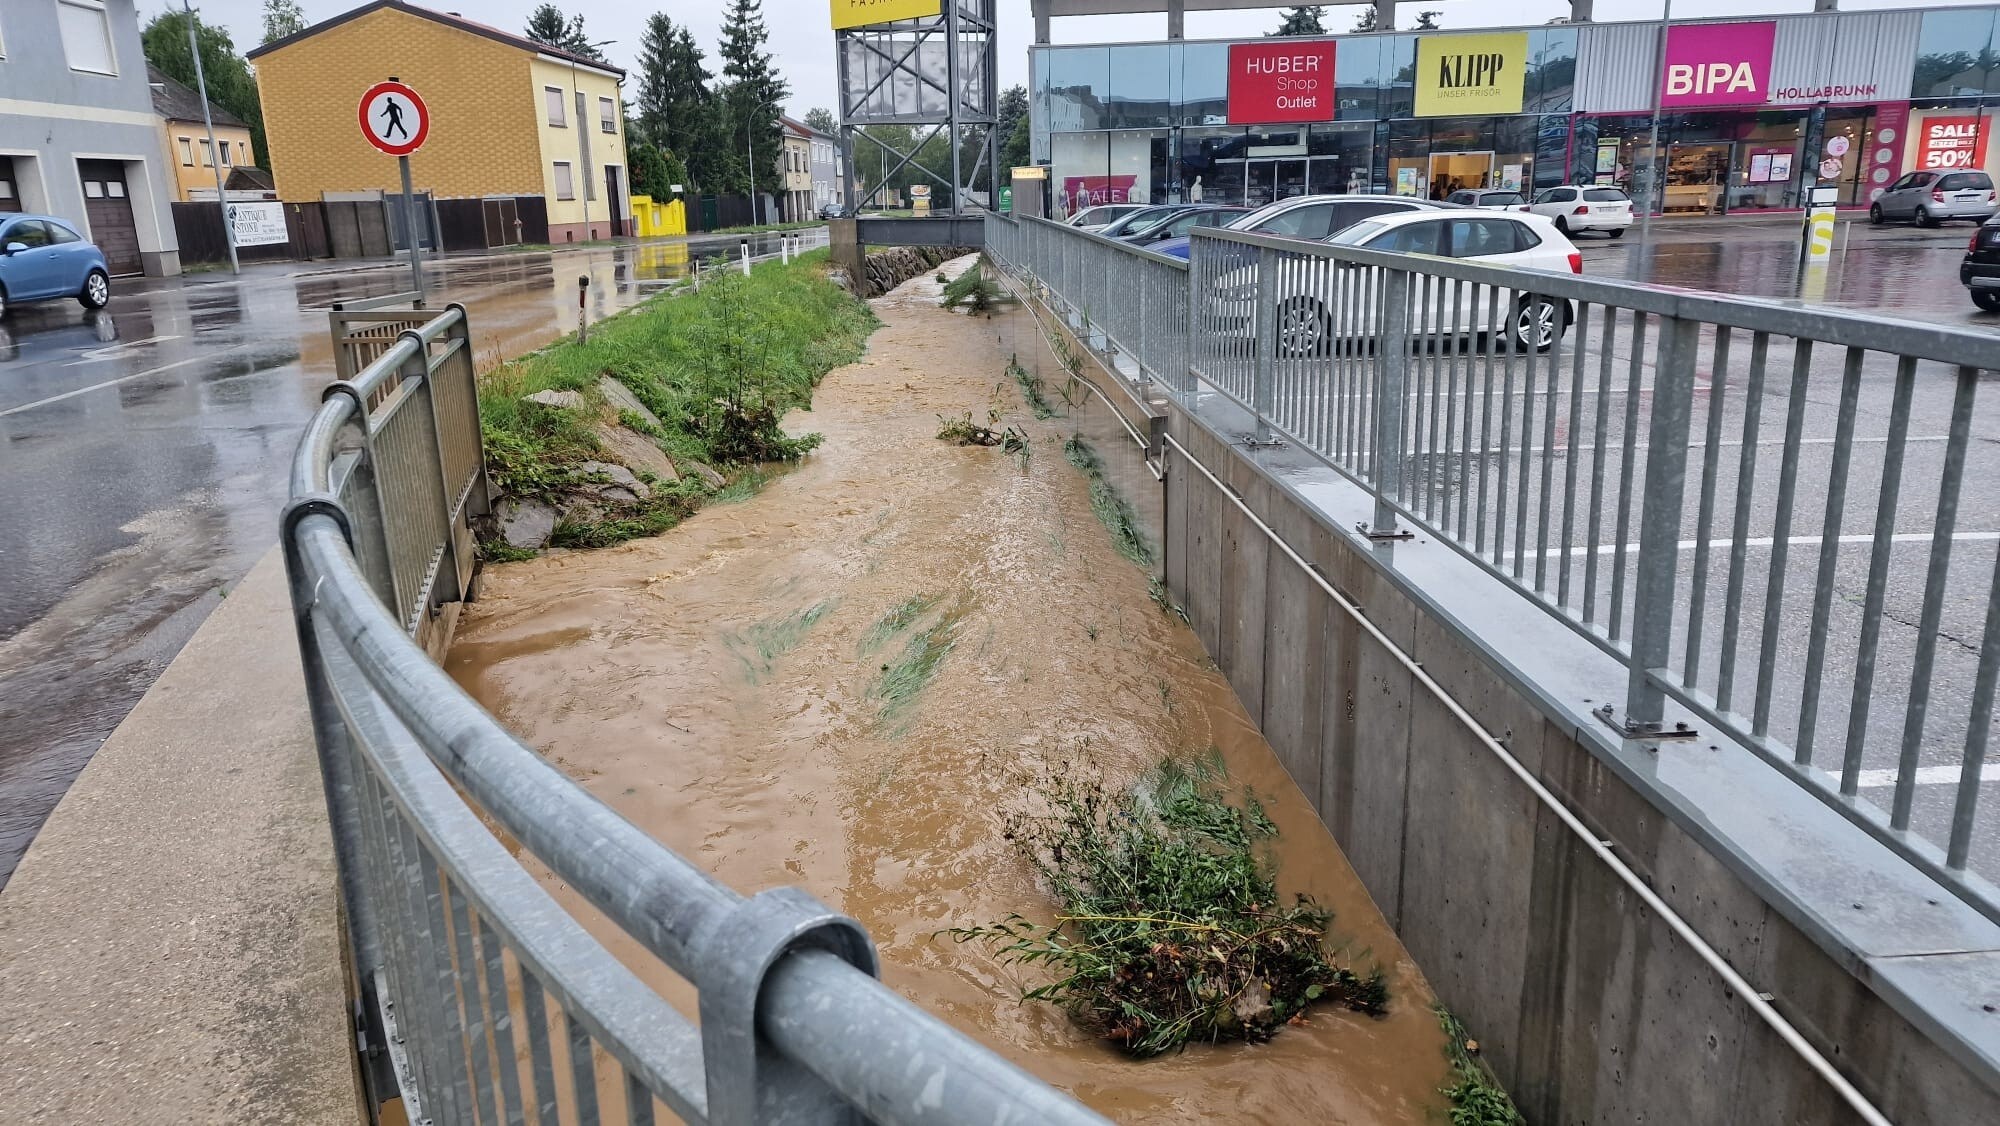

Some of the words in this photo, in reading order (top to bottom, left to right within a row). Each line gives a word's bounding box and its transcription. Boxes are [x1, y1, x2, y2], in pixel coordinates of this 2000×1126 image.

[1247, 55, 1319, 74] HUBER
[1438, 53, 1504, 88] KLIPP
[1277, 76, 1318, 94] Shop
[1666, 61, 1756, 96] BIPA
[1437, 89, 1466, 99] UNSER
[1776, 83, 1877, 100] HOLLABRUNN
[1276, 95, 1317, 109] Outlet
[1930, 124, 1981, 138] SALE
[1926, 150, 1976, 167] 50%
[1091, 189, 1121, 203] ALE
[236, 222, 258, 233] STONE
